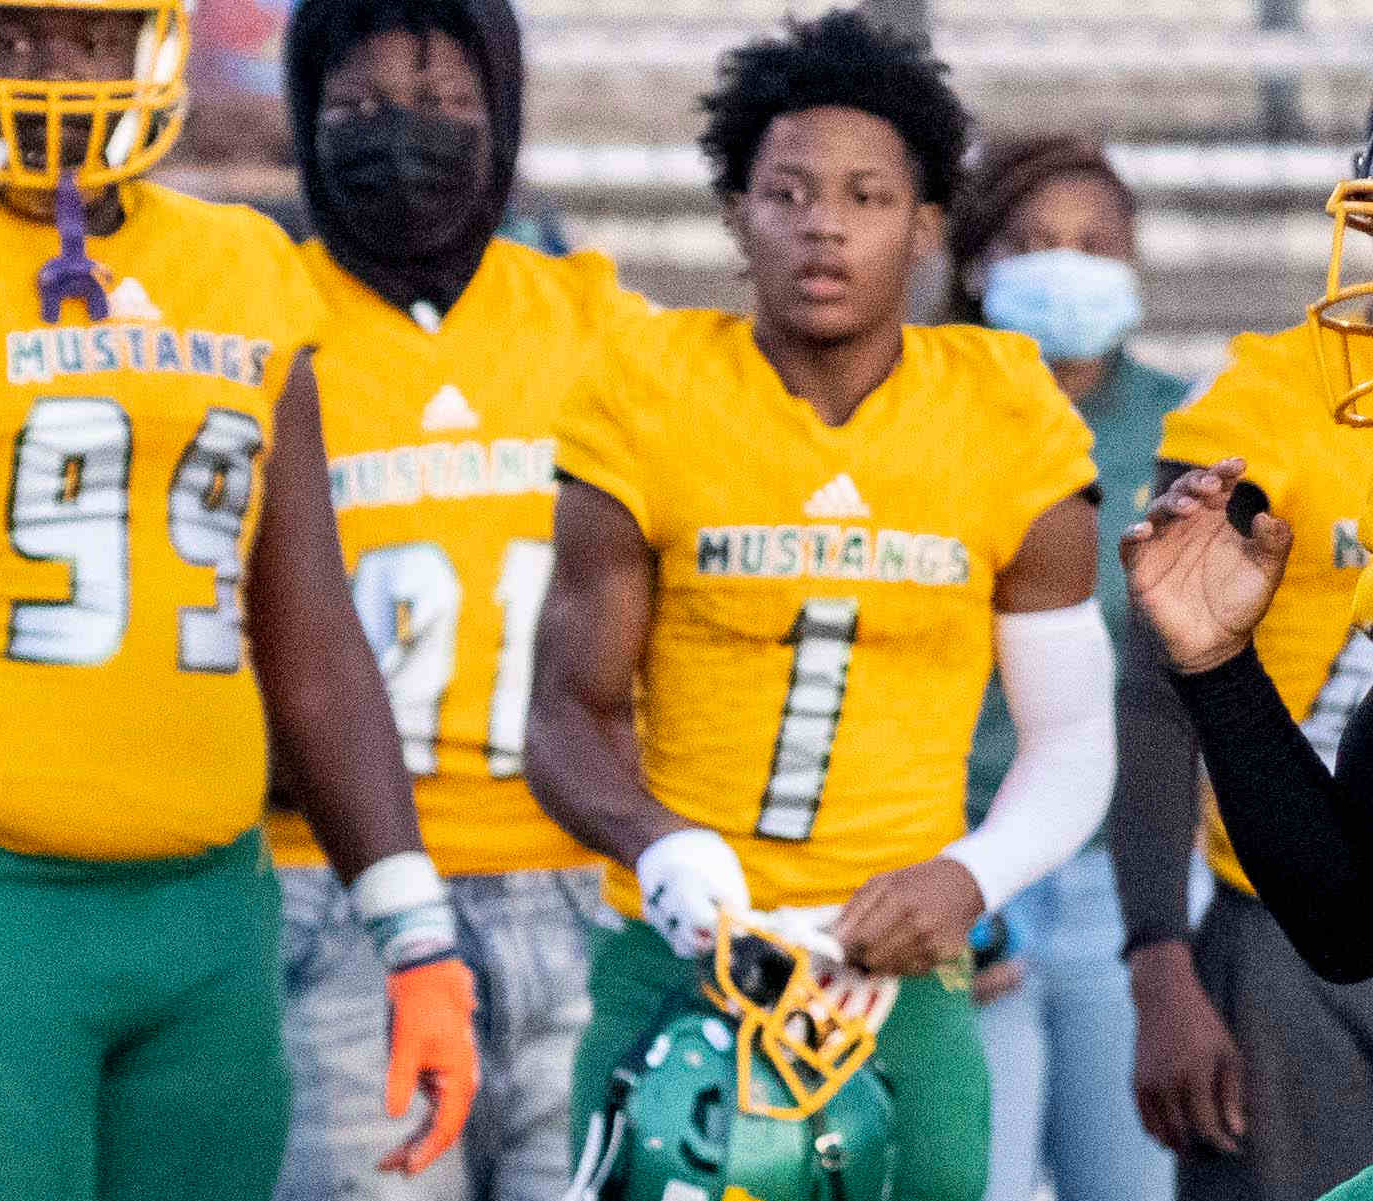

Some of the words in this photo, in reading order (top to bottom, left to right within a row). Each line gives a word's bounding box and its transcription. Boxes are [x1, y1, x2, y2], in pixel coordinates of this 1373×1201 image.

[6, 324, 271, 387] MUSTANGS
[4, 396, 263, 675] 99
[696, 525, 970, 586] MUSTANGS
[754, 596, 860, 842] 1
